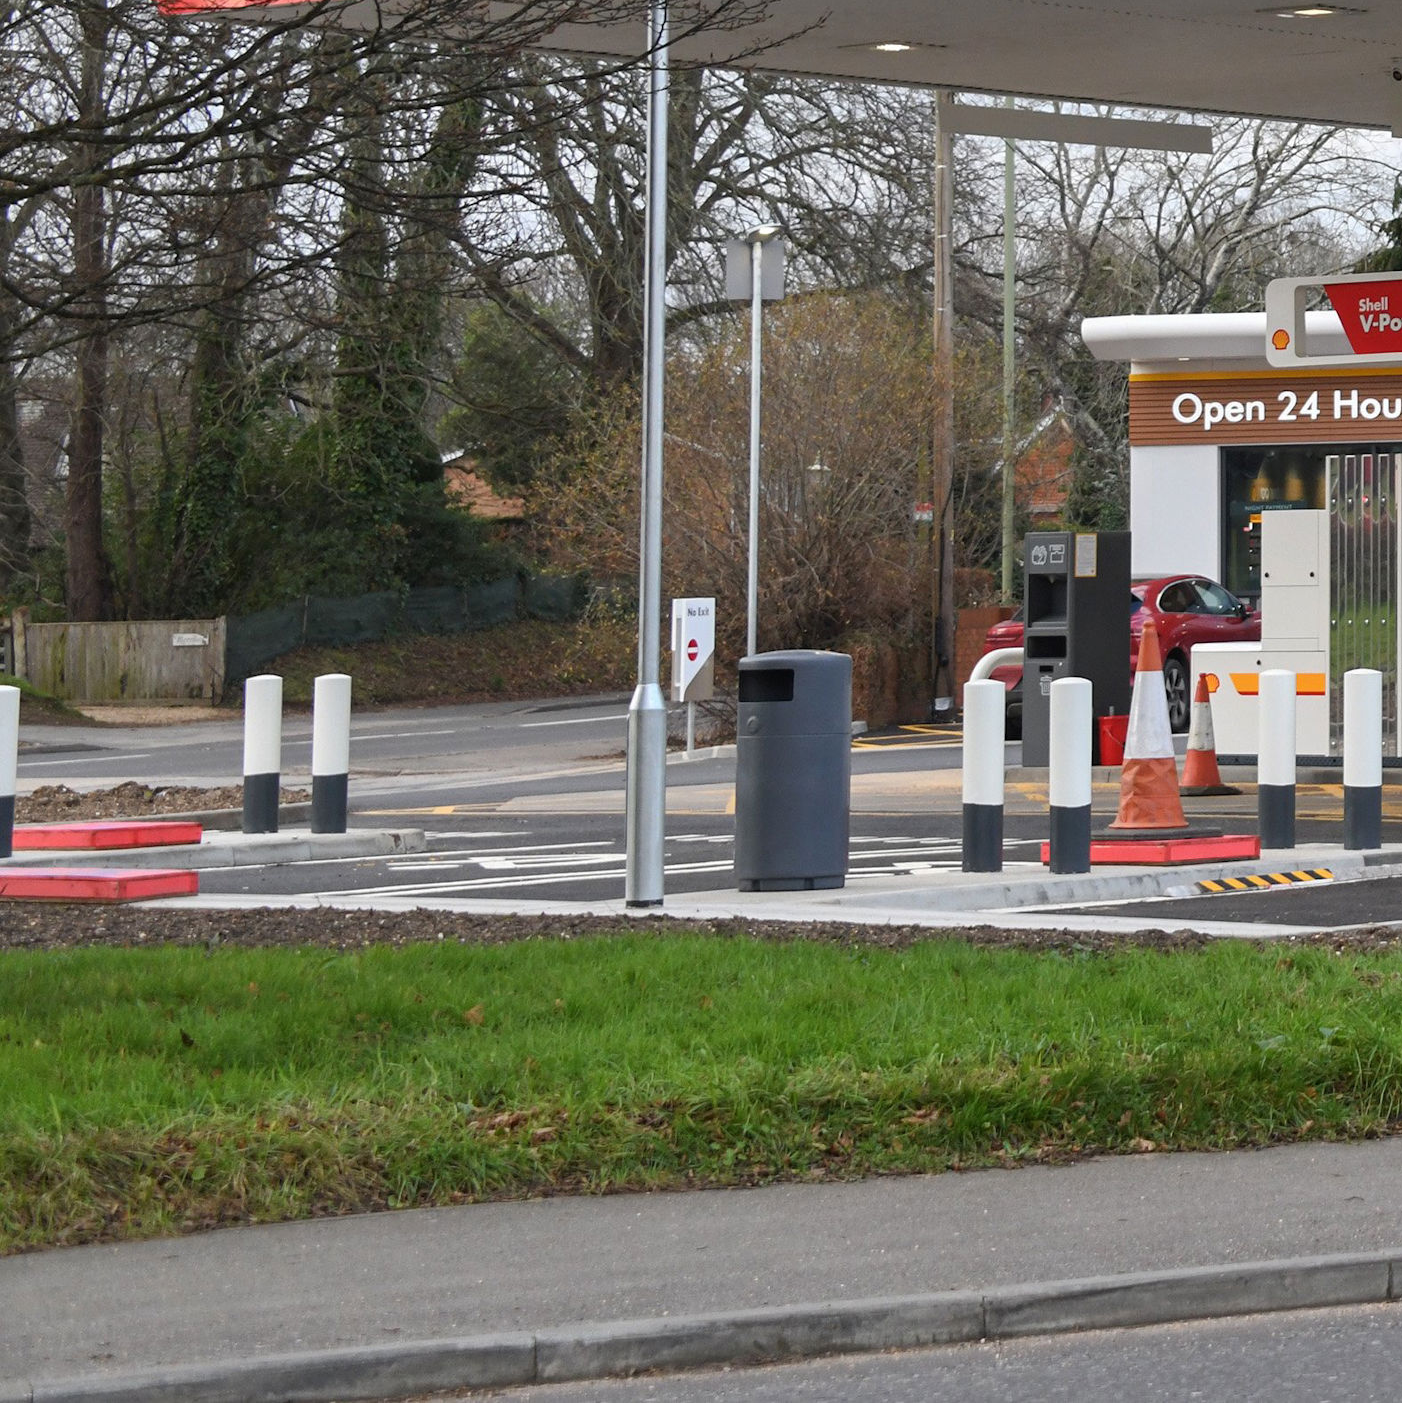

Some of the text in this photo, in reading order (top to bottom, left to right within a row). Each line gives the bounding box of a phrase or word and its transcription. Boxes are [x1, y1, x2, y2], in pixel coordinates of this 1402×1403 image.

[1359, 297, 1388, 312] Shell
[1172, 392, 1266, 430] Open
[1277, 390, 1320, 420] 24
[687, 607, 710, 617] No Exit
